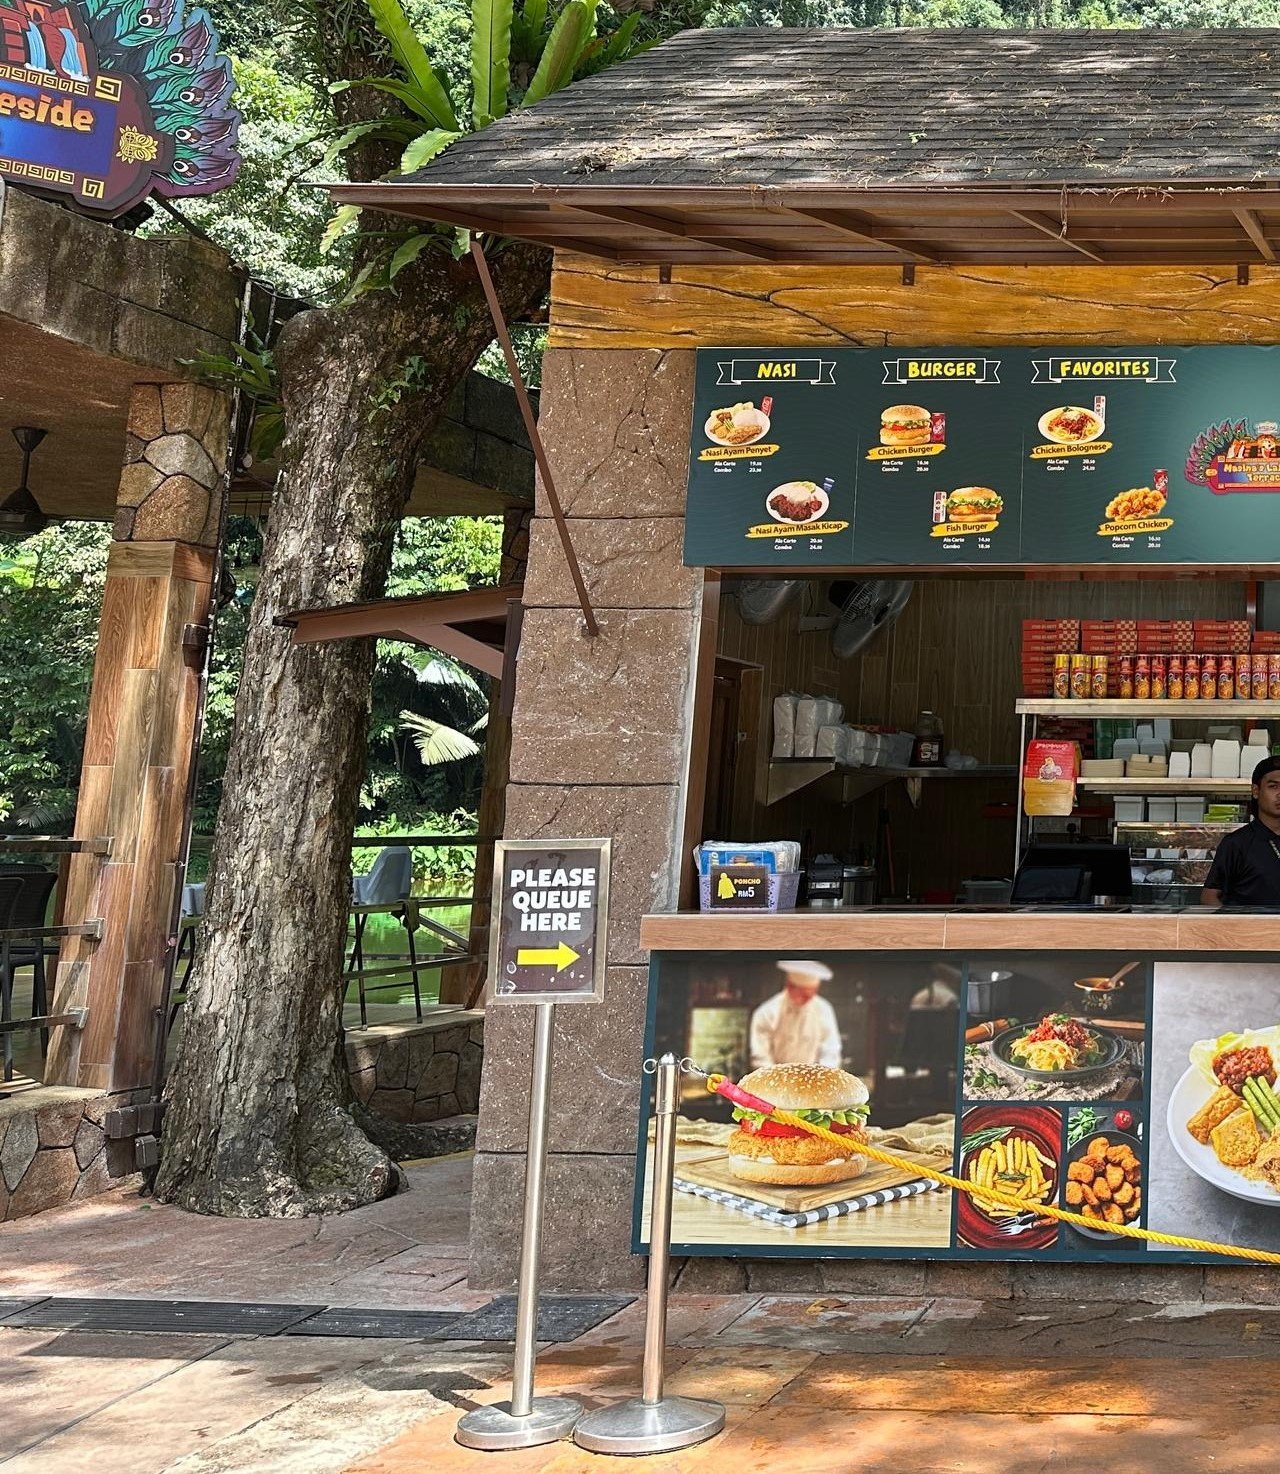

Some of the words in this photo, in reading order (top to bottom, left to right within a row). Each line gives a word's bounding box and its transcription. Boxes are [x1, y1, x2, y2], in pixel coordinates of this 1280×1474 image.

[757, 363, 796, 378] NASI
[908, 362, 977, 377] BURGER
[1060, 361, 1150, 377] FAVORITES
[706, 449, 722, 457] Nasi
[723, 448, 745, 456] Ayam
[746, 446, 772, 455] Penyet
[878, 447, 907, 455] Chicken
[908, 446, 933, 454] Burger
[1035, 446, 1066, 455] Chicken
[1067, 444, 1107, 453] Bolognese
[773, 526, 795, 534] Ayam
[795, 524, 821, 532] Masak
[822, 522, 843, 531] Kicap
[946, 524, 961, 532] Fish
[962, 523, 988, 531] Burger
[1105, 522, 1136, 532] Popcorn
[1137, 520, 1168, 529] Chicken
[510, 868, 595, 888] PLEASE
[738, 886, 755, 898] RM5
[512, 890, 592, 914] QUEUE
[520, 912, 581, 932] HERE
